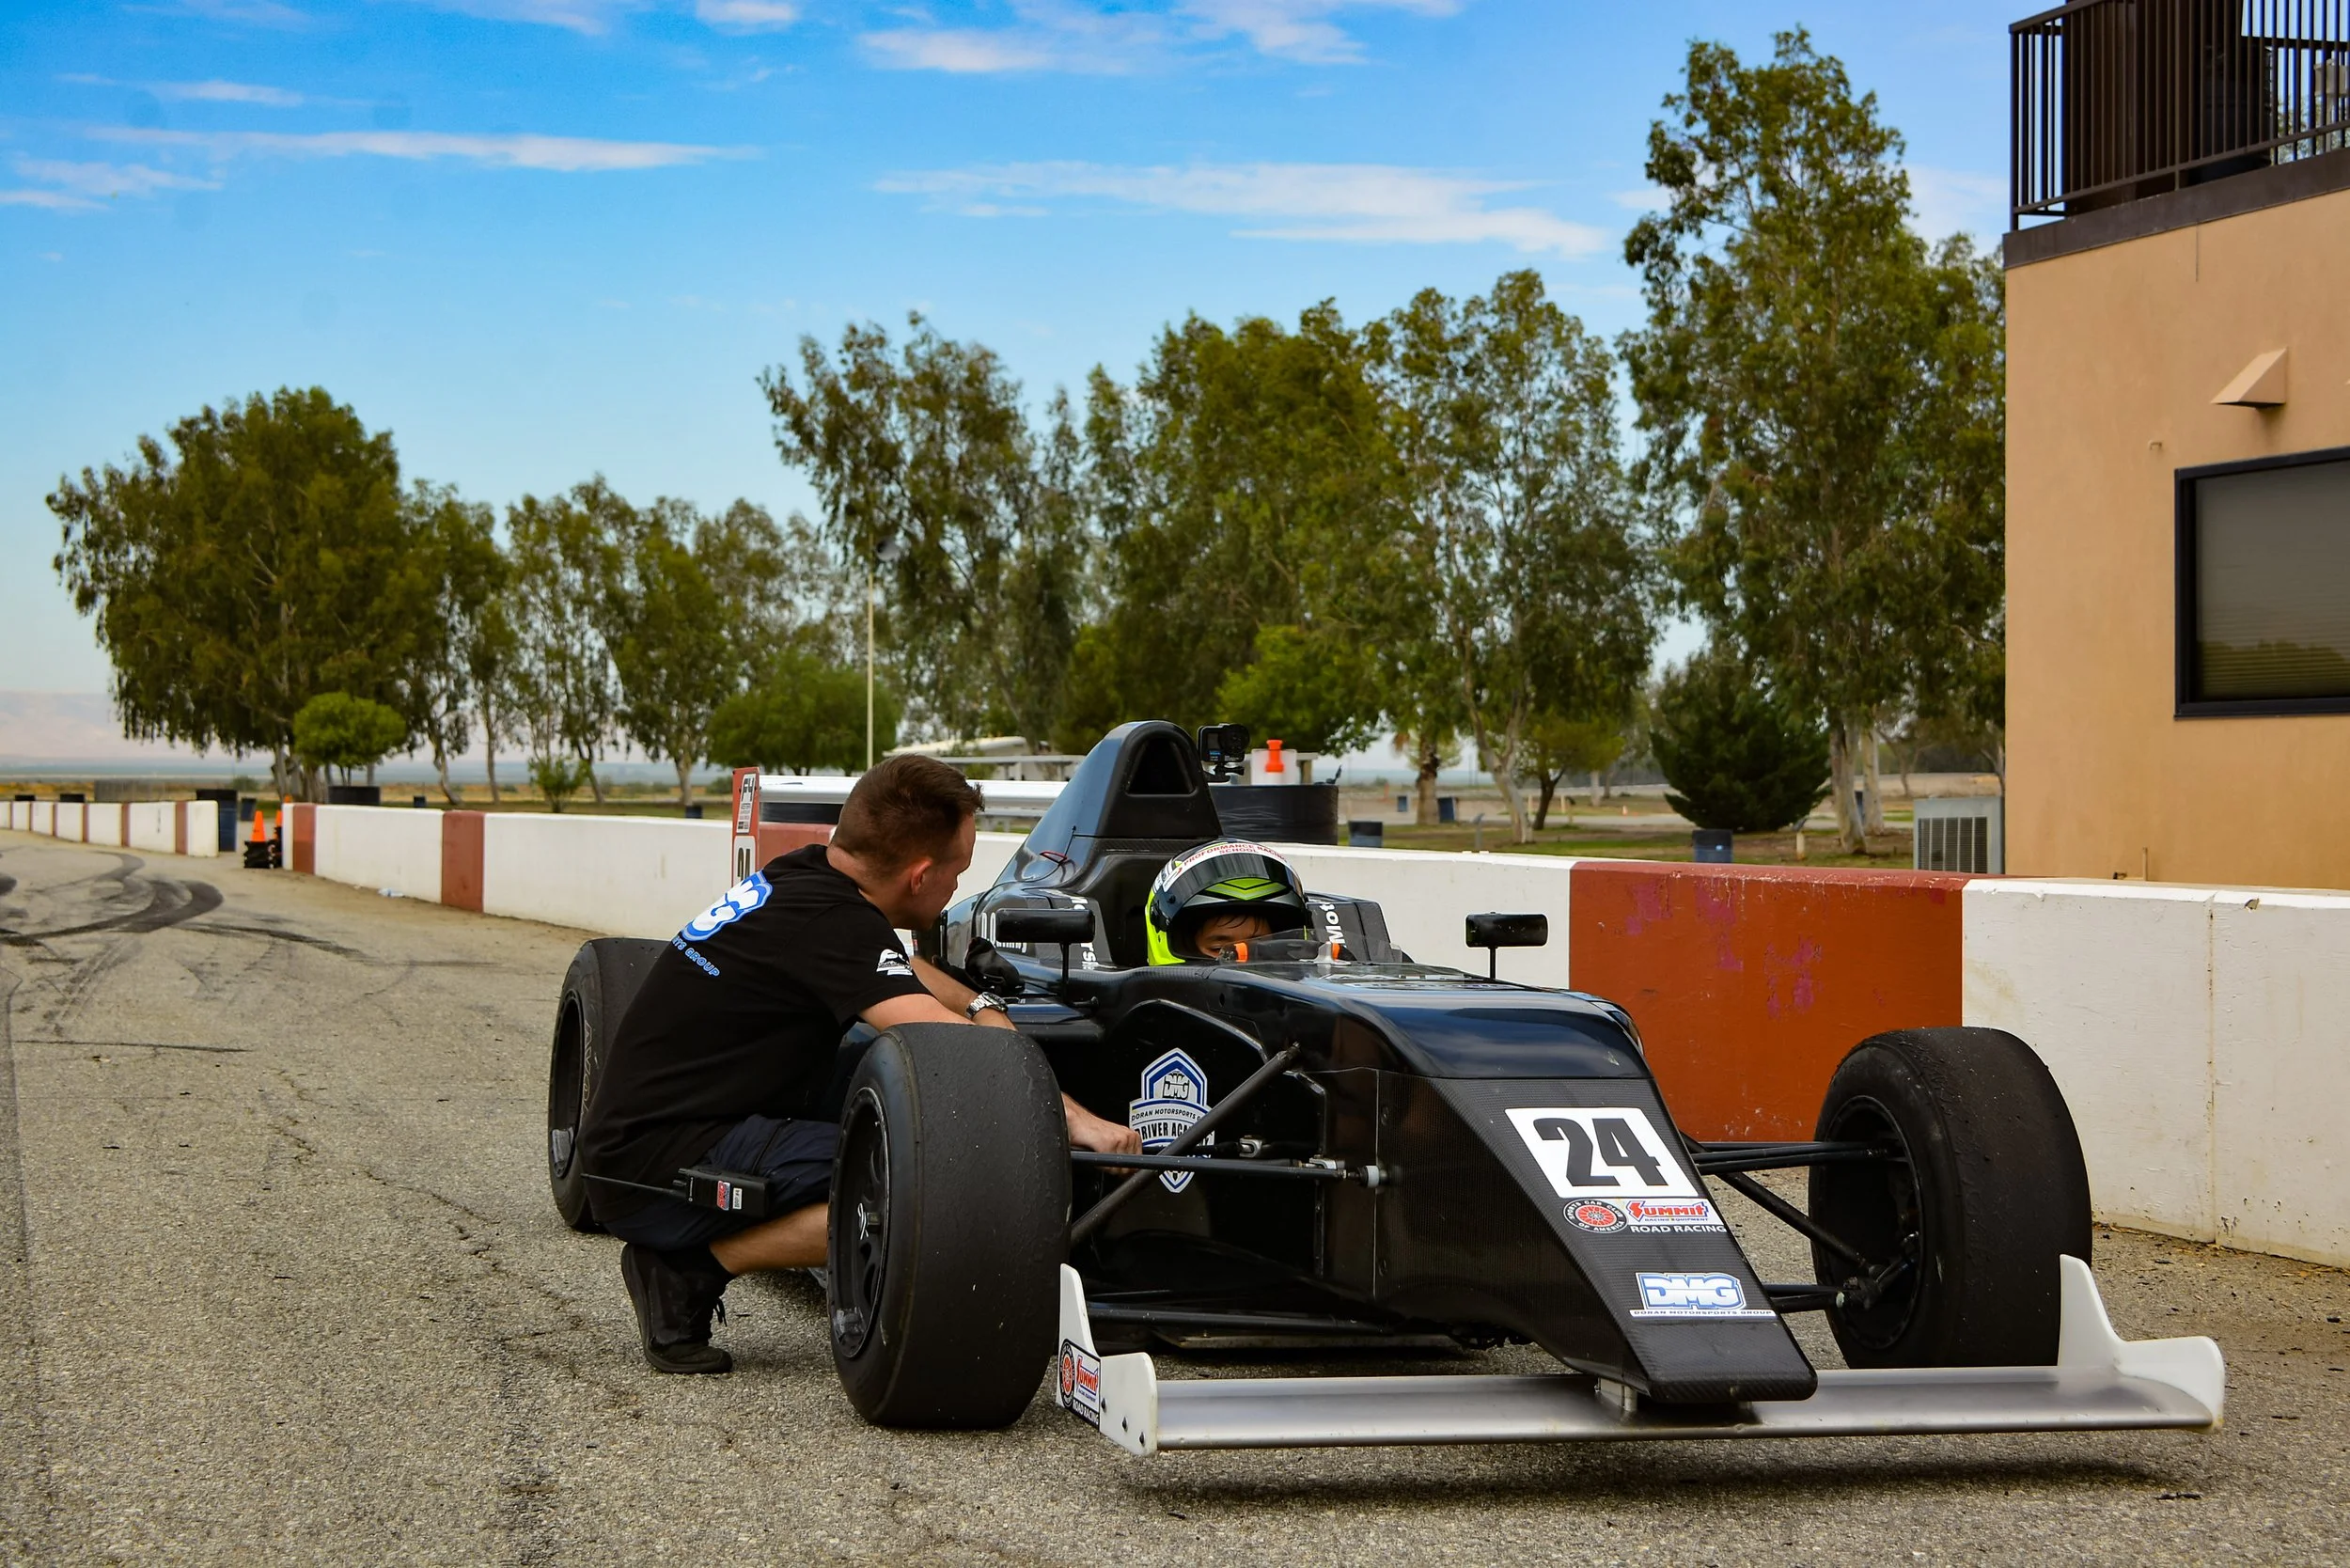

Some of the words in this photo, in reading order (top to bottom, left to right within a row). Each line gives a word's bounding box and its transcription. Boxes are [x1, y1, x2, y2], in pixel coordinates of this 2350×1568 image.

[1184, 843, 1255, 866] PROFORMANCE
[685, 947, 720, 977] GROUP
[1131, 1110, 1153, 1121] DORAN
[1154, 1108, 1196, 1120] MOTORSPORTS
[1533, 1117, 1668, 1187] 24
[1567, 1201, 1582, 1220] SPORTS
[1593, 1221, 1625, 1231] AMERICA
[1673, 1225, 1728, 1233] RACING
[1639, 1276, 1744, 1308] DMG
